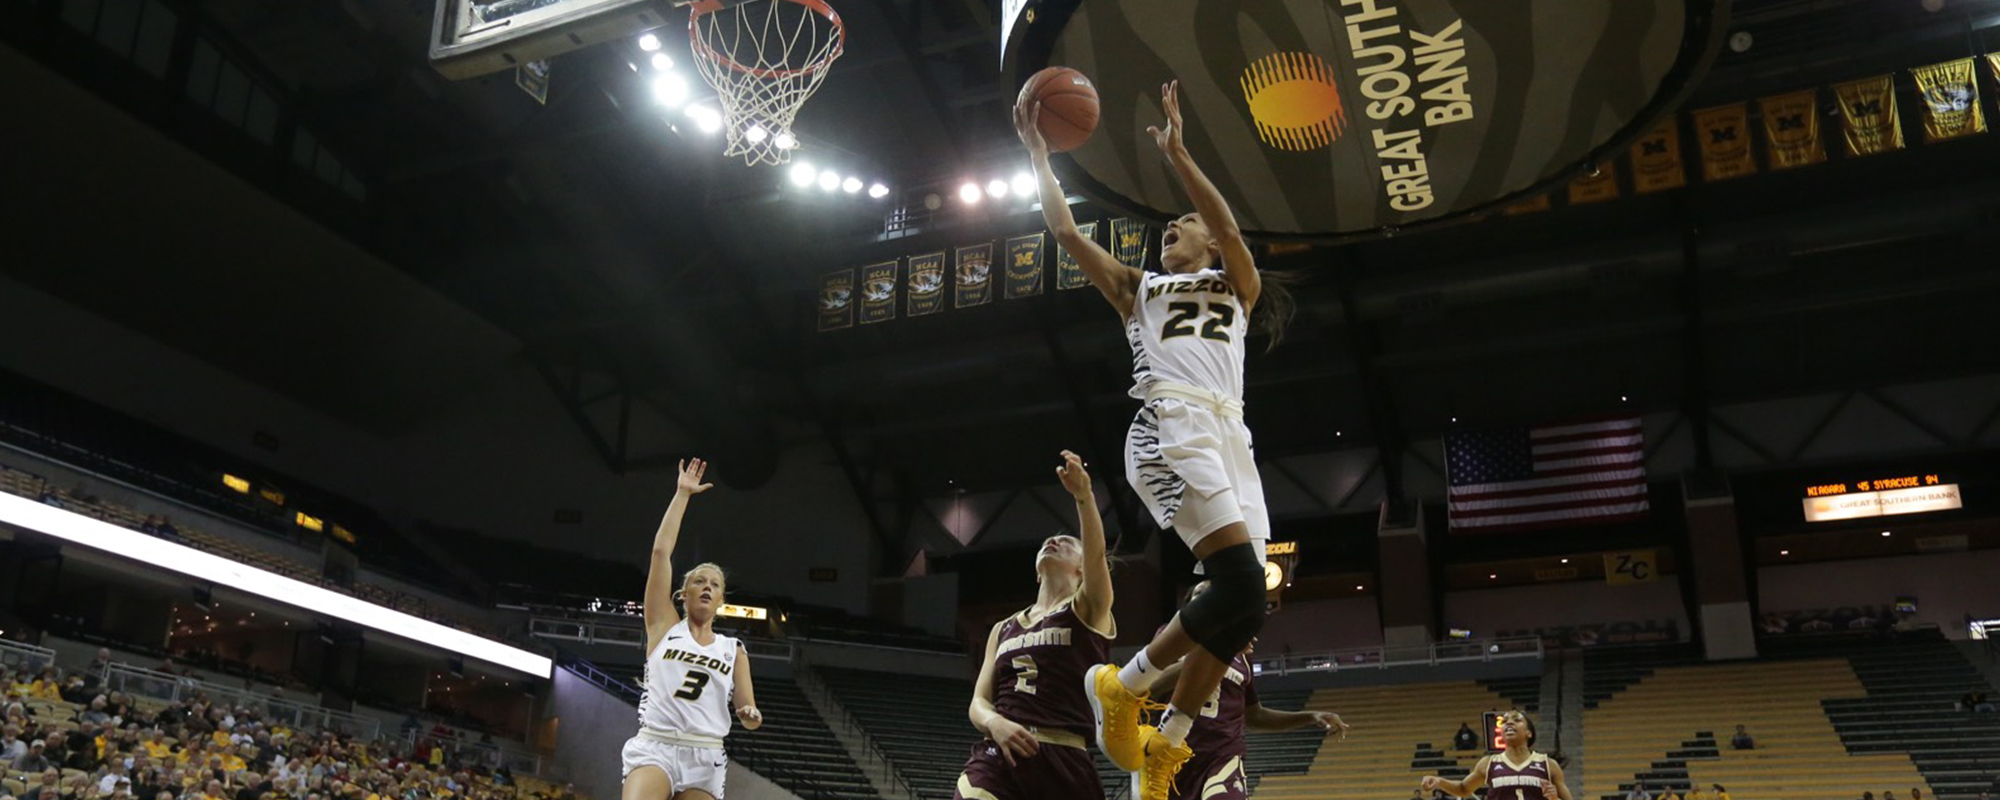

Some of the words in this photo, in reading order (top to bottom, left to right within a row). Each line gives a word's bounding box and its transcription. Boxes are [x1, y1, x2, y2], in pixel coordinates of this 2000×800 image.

[1409, 18, 1474, 127] BANK
[1372, 128, 1434, 211] GREAT
[916, 261, 938, 270] NCAA
[963, 252, 985, 261] NCAA
[1015, 252, 1034, 267] M
[869, 269, 891, 278] NCAA
[1161, 302, 1235, 344] 22
[1807, 483, 1846, 497] NIAGARA
[1857, 481, 1869, 491] 45
[1873, 476, 1919, 490] SYRACUSE
[1840, 499, 1871, 509] GREAT
[1873, 494, 1926, 506] SOUTHERN
[1928, 490, 1957, 501] BANK
[1265, 541, 1296, 555] ZOU
[1615, 554, 1649, 580] ZC
[662, 648, 731, 676] MIZZOU
[673, 669, 710, 701] 3
[1011, 654, 1038, 695] 2
